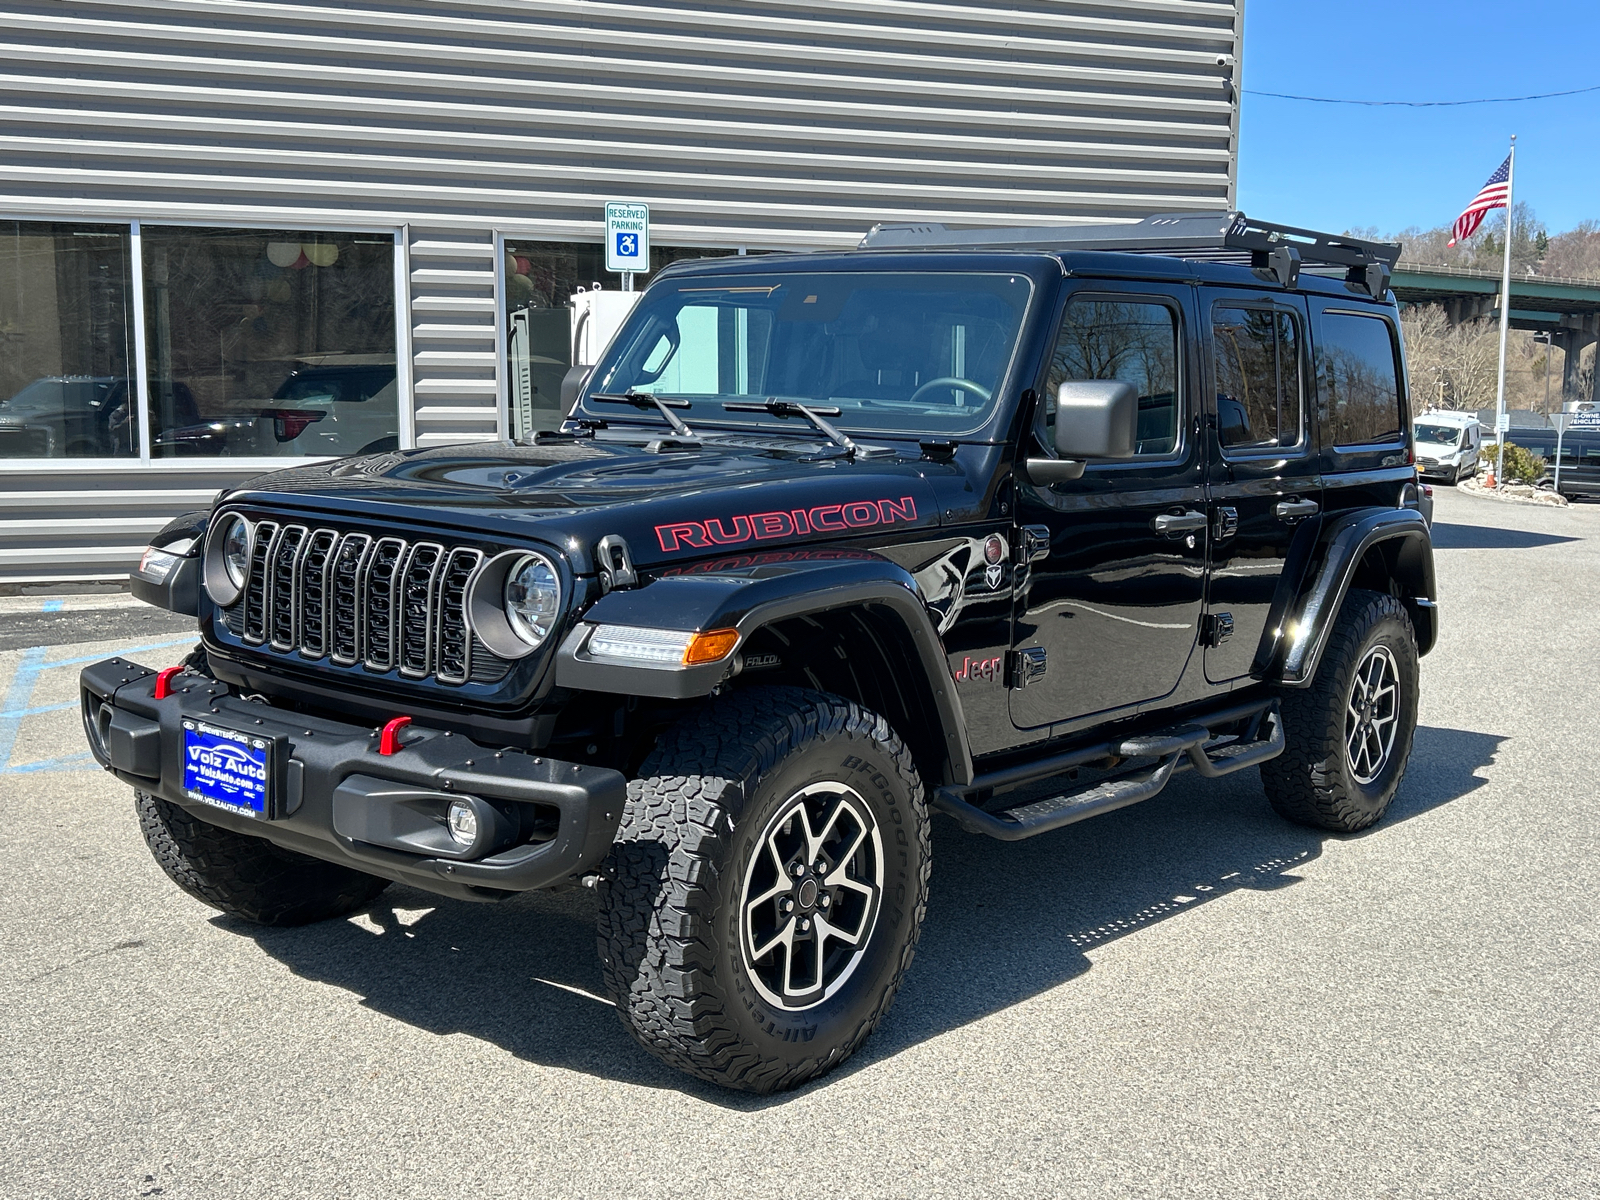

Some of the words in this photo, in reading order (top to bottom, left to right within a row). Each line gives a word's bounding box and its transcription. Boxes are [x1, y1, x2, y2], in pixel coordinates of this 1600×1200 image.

[609, 208, 645, 219] RESERVED
[611, 220, 643, 231] PARKING
[654, 496, 918, 552] RUBICON
[955, 656, 1002, 684] Jeep
[188, 745, 222, 768] Volz
[224, 758, 267, 781] Auto
[200, 764, 254, 790] VolzAuto.com
[187, 790, 256, 818] WWW.VOLZAUTO.COM
[839, 755, 909, 930] BFGoodrich
[728, 914, 819, 1043] All-Terrain
